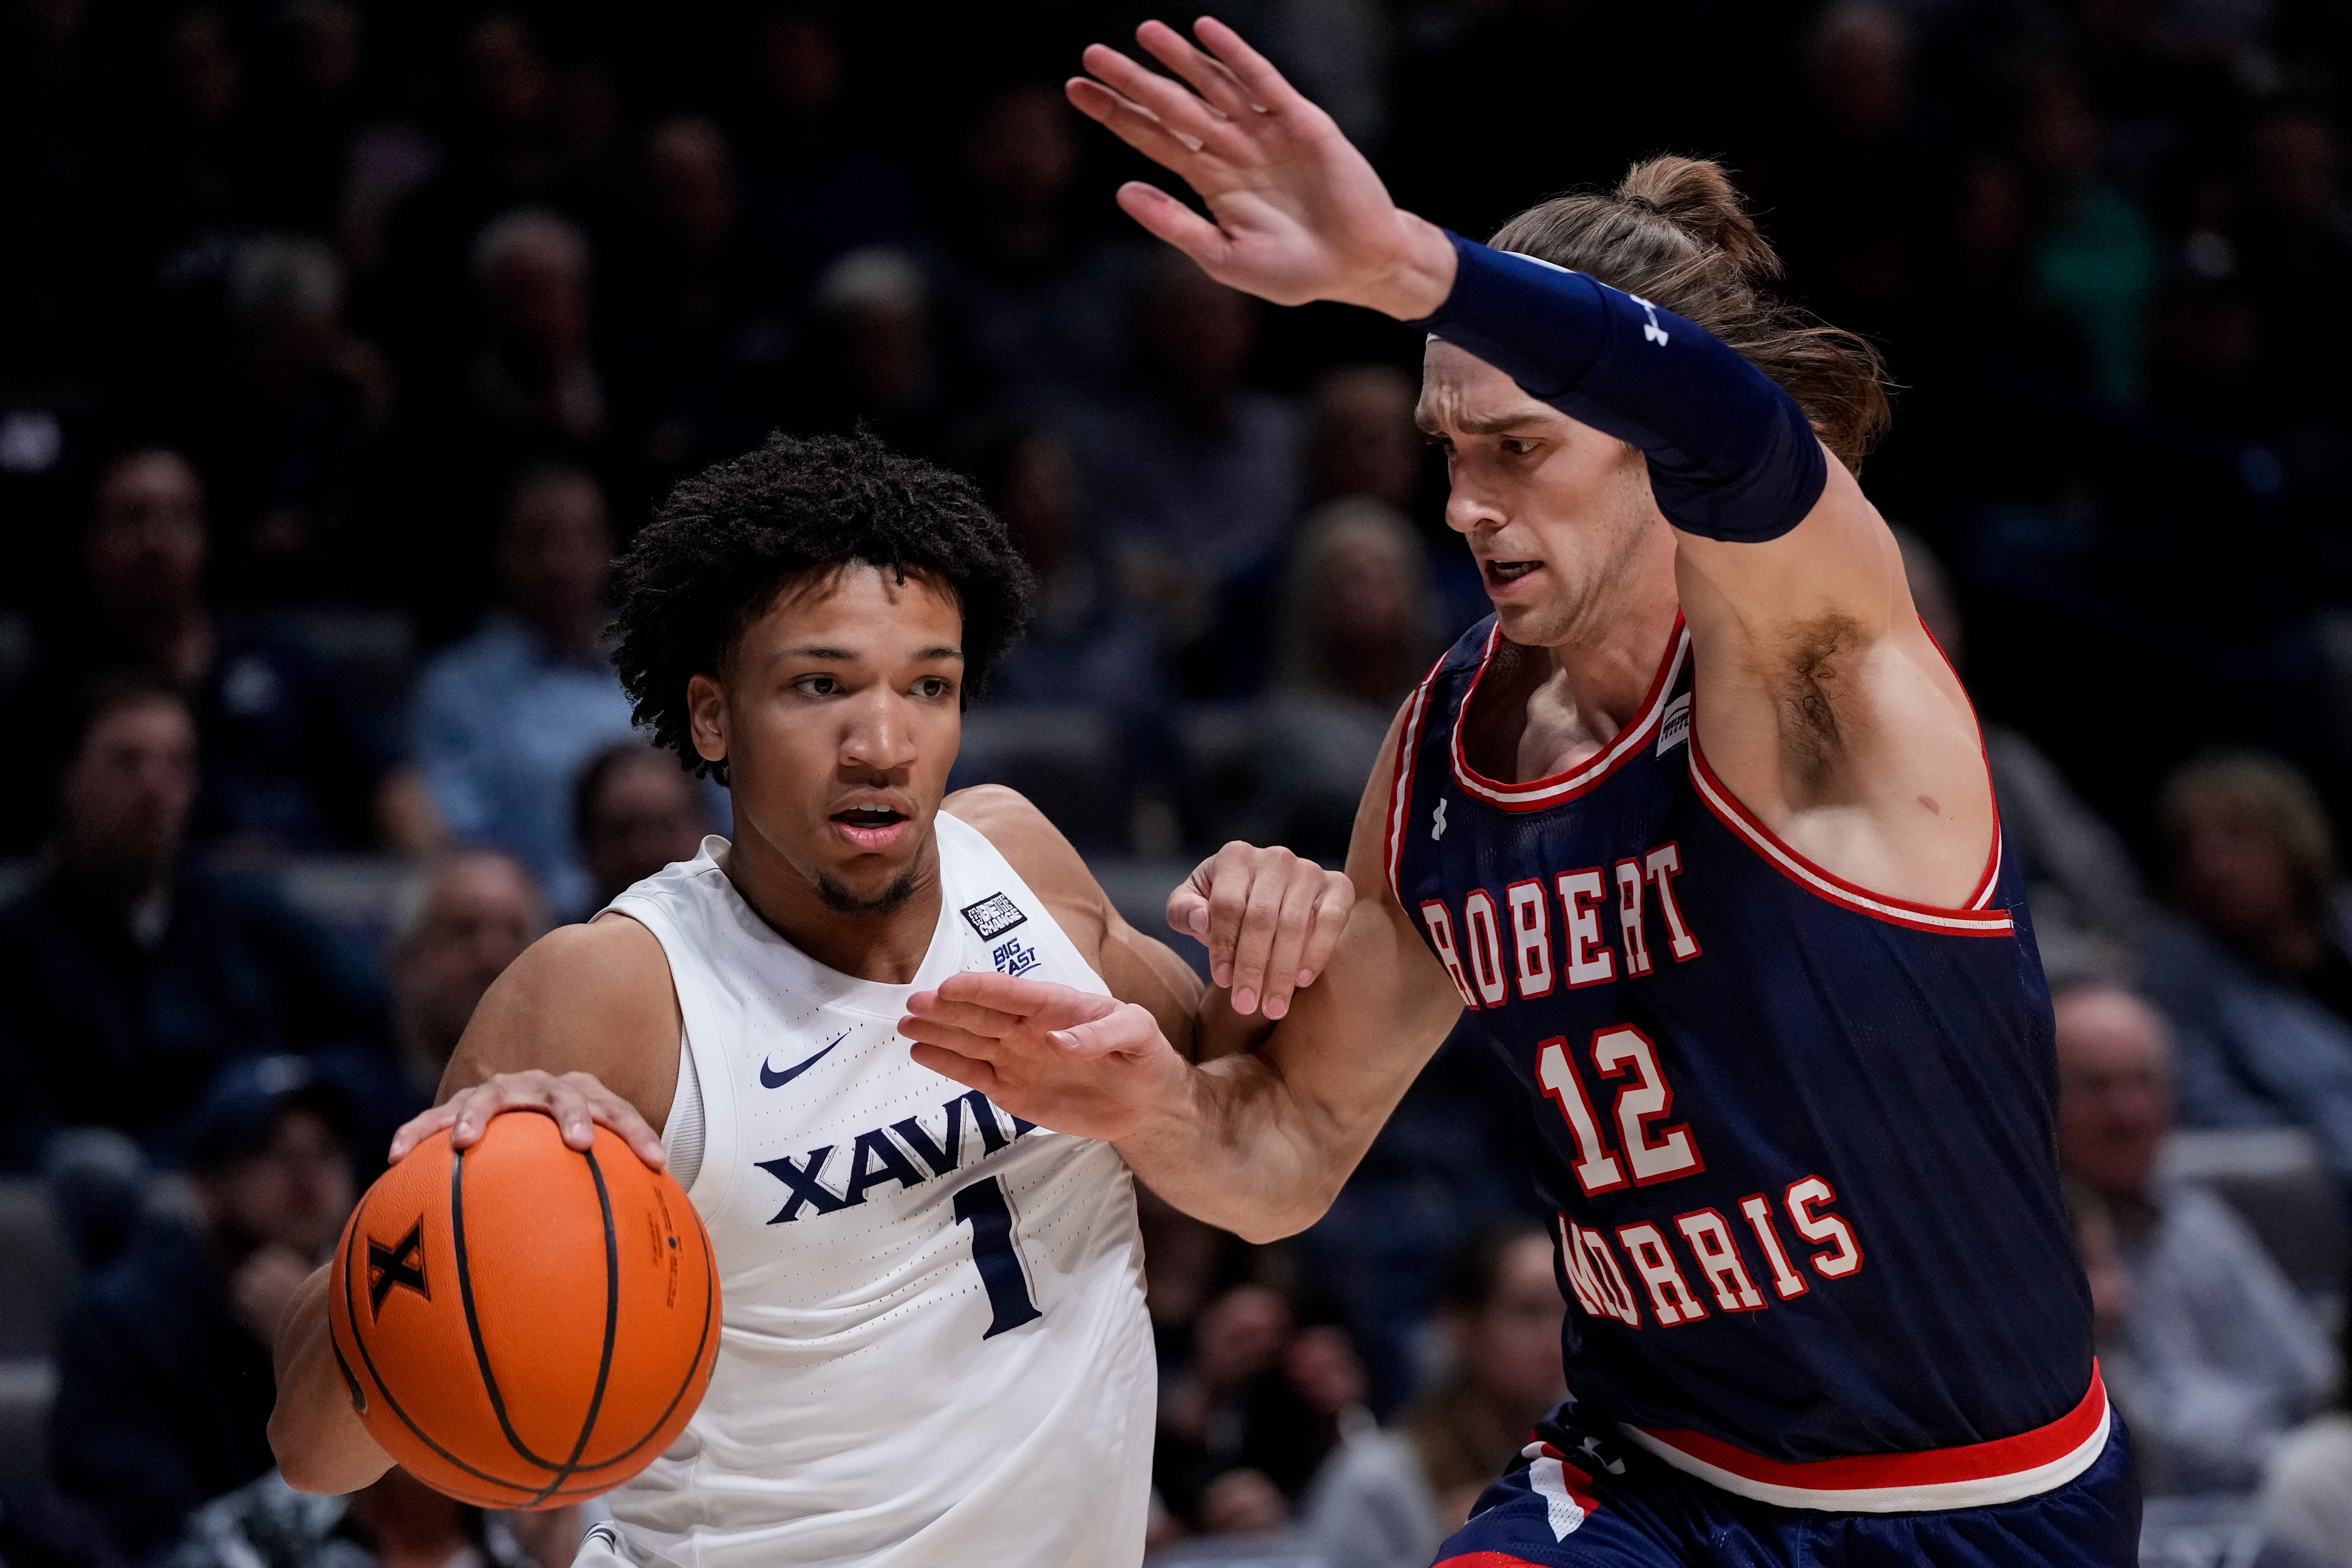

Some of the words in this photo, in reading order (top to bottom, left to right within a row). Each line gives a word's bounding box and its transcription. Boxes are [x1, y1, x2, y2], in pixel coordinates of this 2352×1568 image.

[979, 908, 1023, 936] CHANGE
[993, 937, 1021, 966] BIG
[1420, 840, 1702, 1010] ROBERT
[754, 1090, 1038, 1225] XAVI
[1535, 1022, 1706, 1197] 12
[953, 1175, 1042, 1340] 1
[1559, 1174, 1864, 1330] MORRIS
